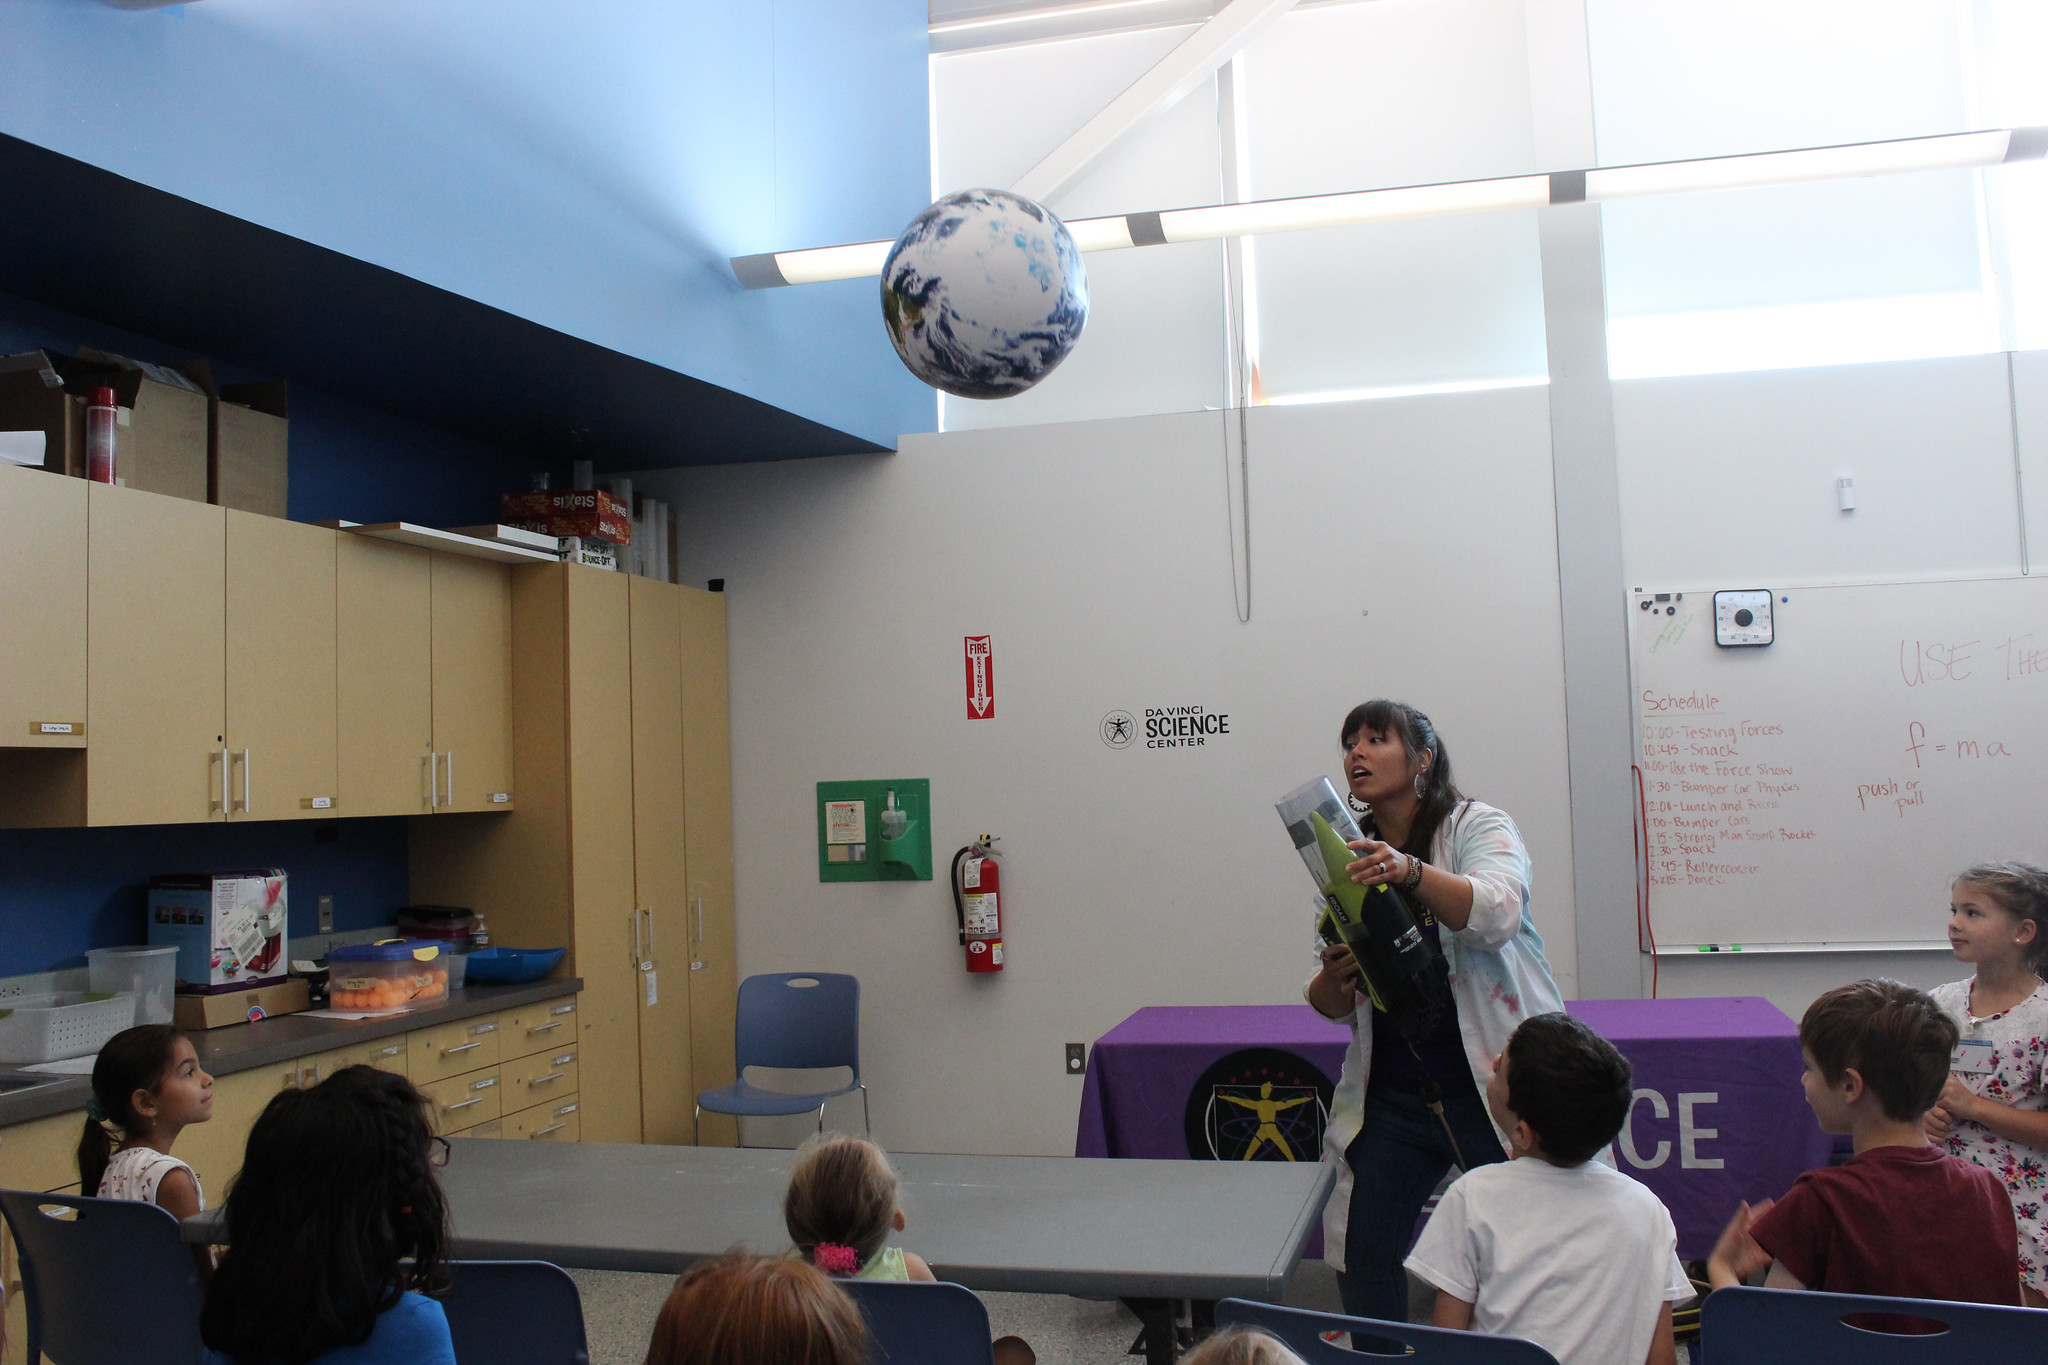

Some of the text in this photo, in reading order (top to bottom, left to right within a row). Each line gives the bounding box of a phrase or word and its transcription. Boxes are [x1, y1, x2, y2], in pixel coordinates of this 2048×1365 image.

[969, 642, 988, 655] FIRE
[1900, 639, 1981, 687] USE
[1642, 690, 1721, 711] Schedule
[1145, 705, 1204, 718] DA VINCI
[1145, 713, 1231, 738] SCIENCE
[1680, 725, 1737, 744] Testing
[1740, 720, 1784, 736] Forces
[1146, 737, 1206, 749] CENTER
[1690, 743, 1739, 757] Snack
[1688, 761, 1710, 776] the
[1714, 760, 1752, 777] Force
[1756, 763, 1793, 776] Show
[1680, 780, 1731, 797] Bumper
[1857, 777, 1921, 811] push or
[1680, 801, 1717, 812] Lunch
[1720, 800, 1744, 811] and
[1894, 790, 1925, 819] pull
[1673, 816, 1721, 831] Bumper
[1727, 815, 1751, 827] Cars
[1679, 843, 1716, 855] Snack
